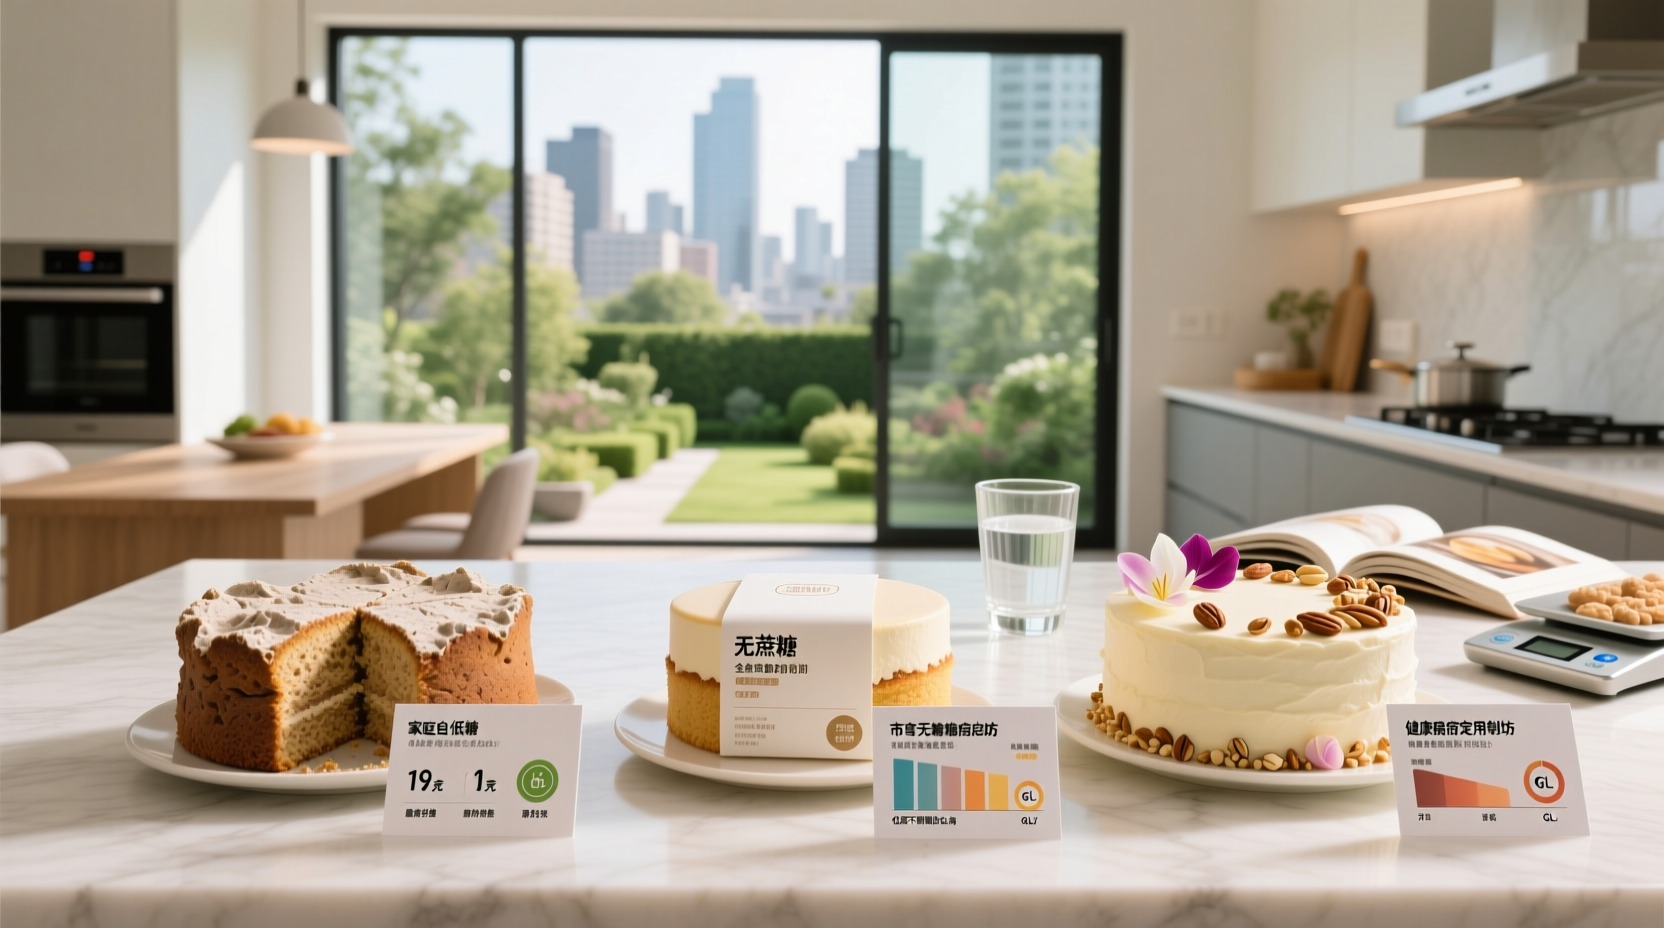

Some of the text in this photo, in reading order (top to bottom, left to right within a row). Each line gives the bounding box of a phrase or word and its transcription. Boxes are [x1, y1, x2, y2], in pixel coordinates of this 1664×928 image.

[735, 633, 797, 657] 无蔗糖
[1534, 776, 1554, 789] GL
[1021, 790, 1037, 802] GL
